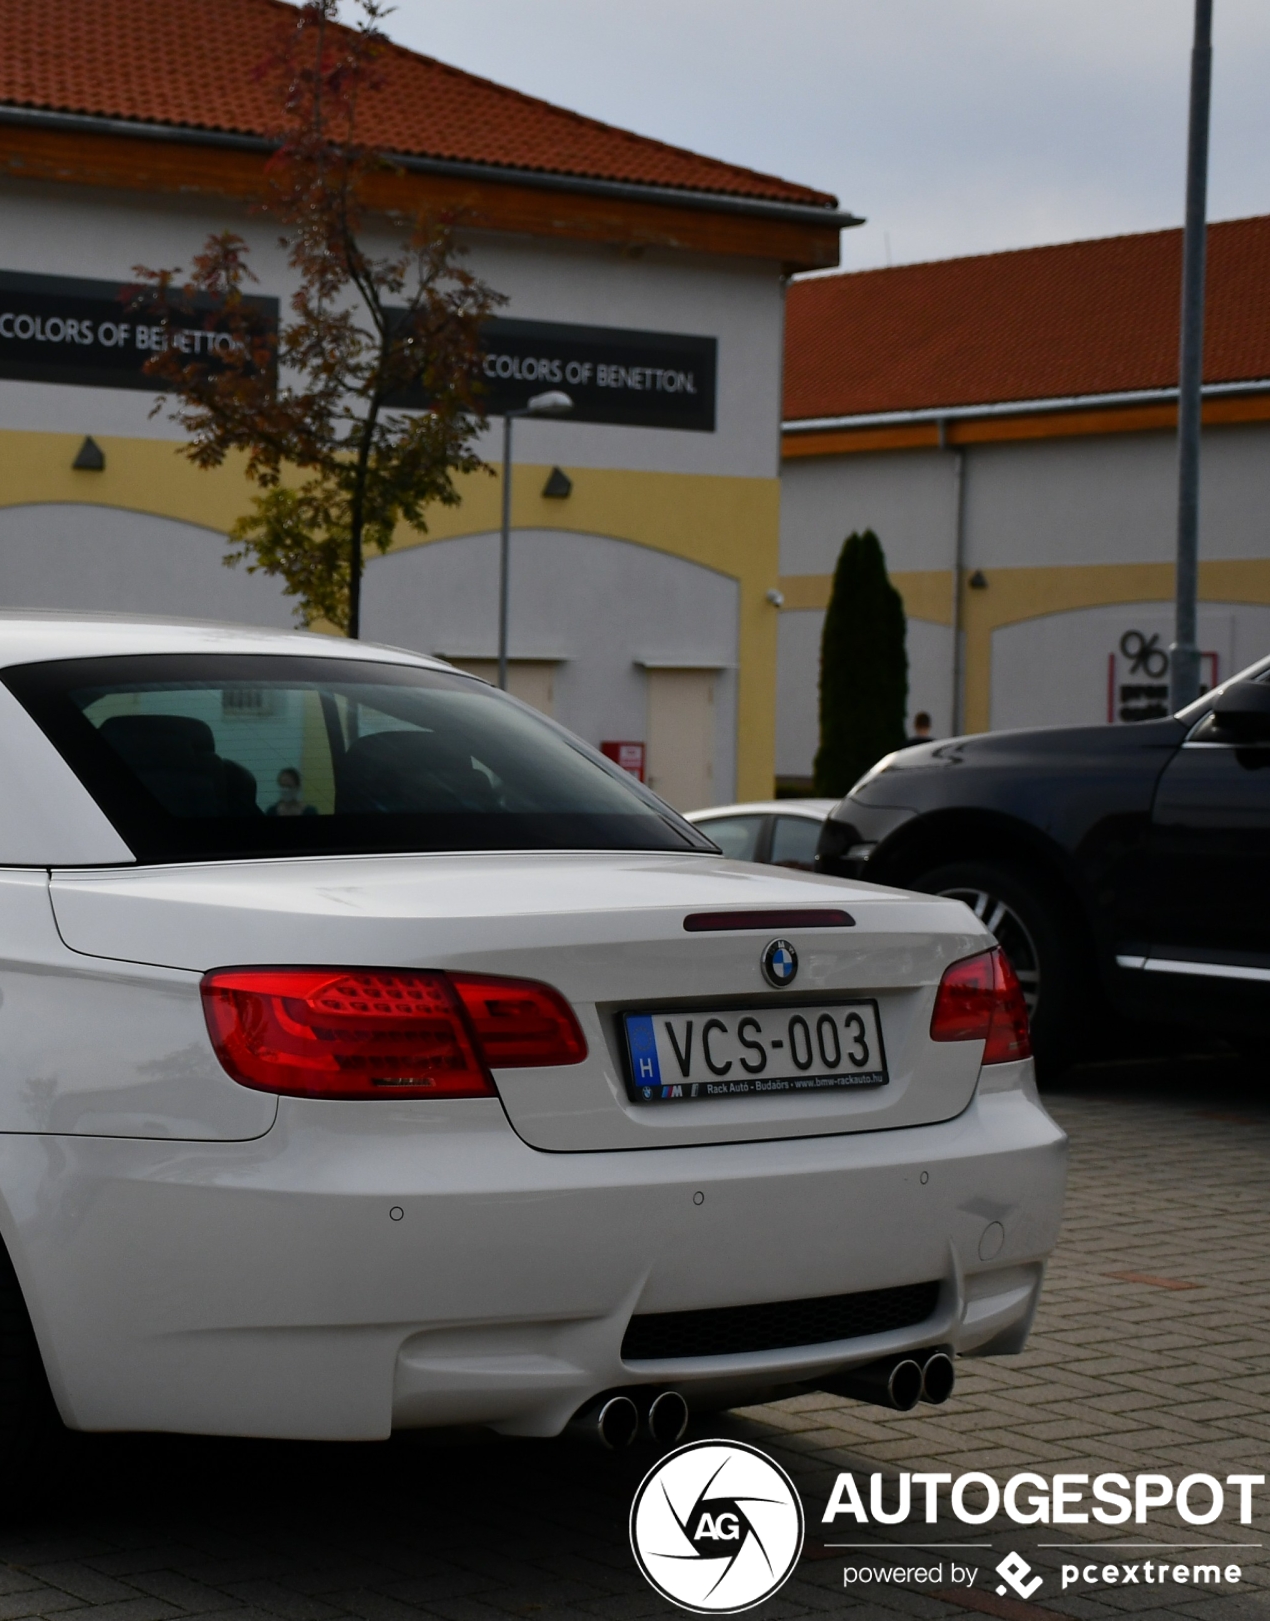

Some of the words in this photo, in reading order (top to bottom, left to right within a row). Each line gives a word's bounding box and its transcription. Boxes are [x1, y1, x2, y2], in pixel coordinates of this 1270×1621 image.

[97, 321, 131, 348] OF
[482, 353, 561, 383] COLORS
[565, 360, 593, 386] OF
[664, 1011, 870, 1078] VCS-003
[639, 1057, 654, 1078] H
[706, 1084, 728, 1095] Rack
[729, 1081, 749, 1093] Autó
[794, 1074, 884, 1088] www.bmw-rackauto.hu
